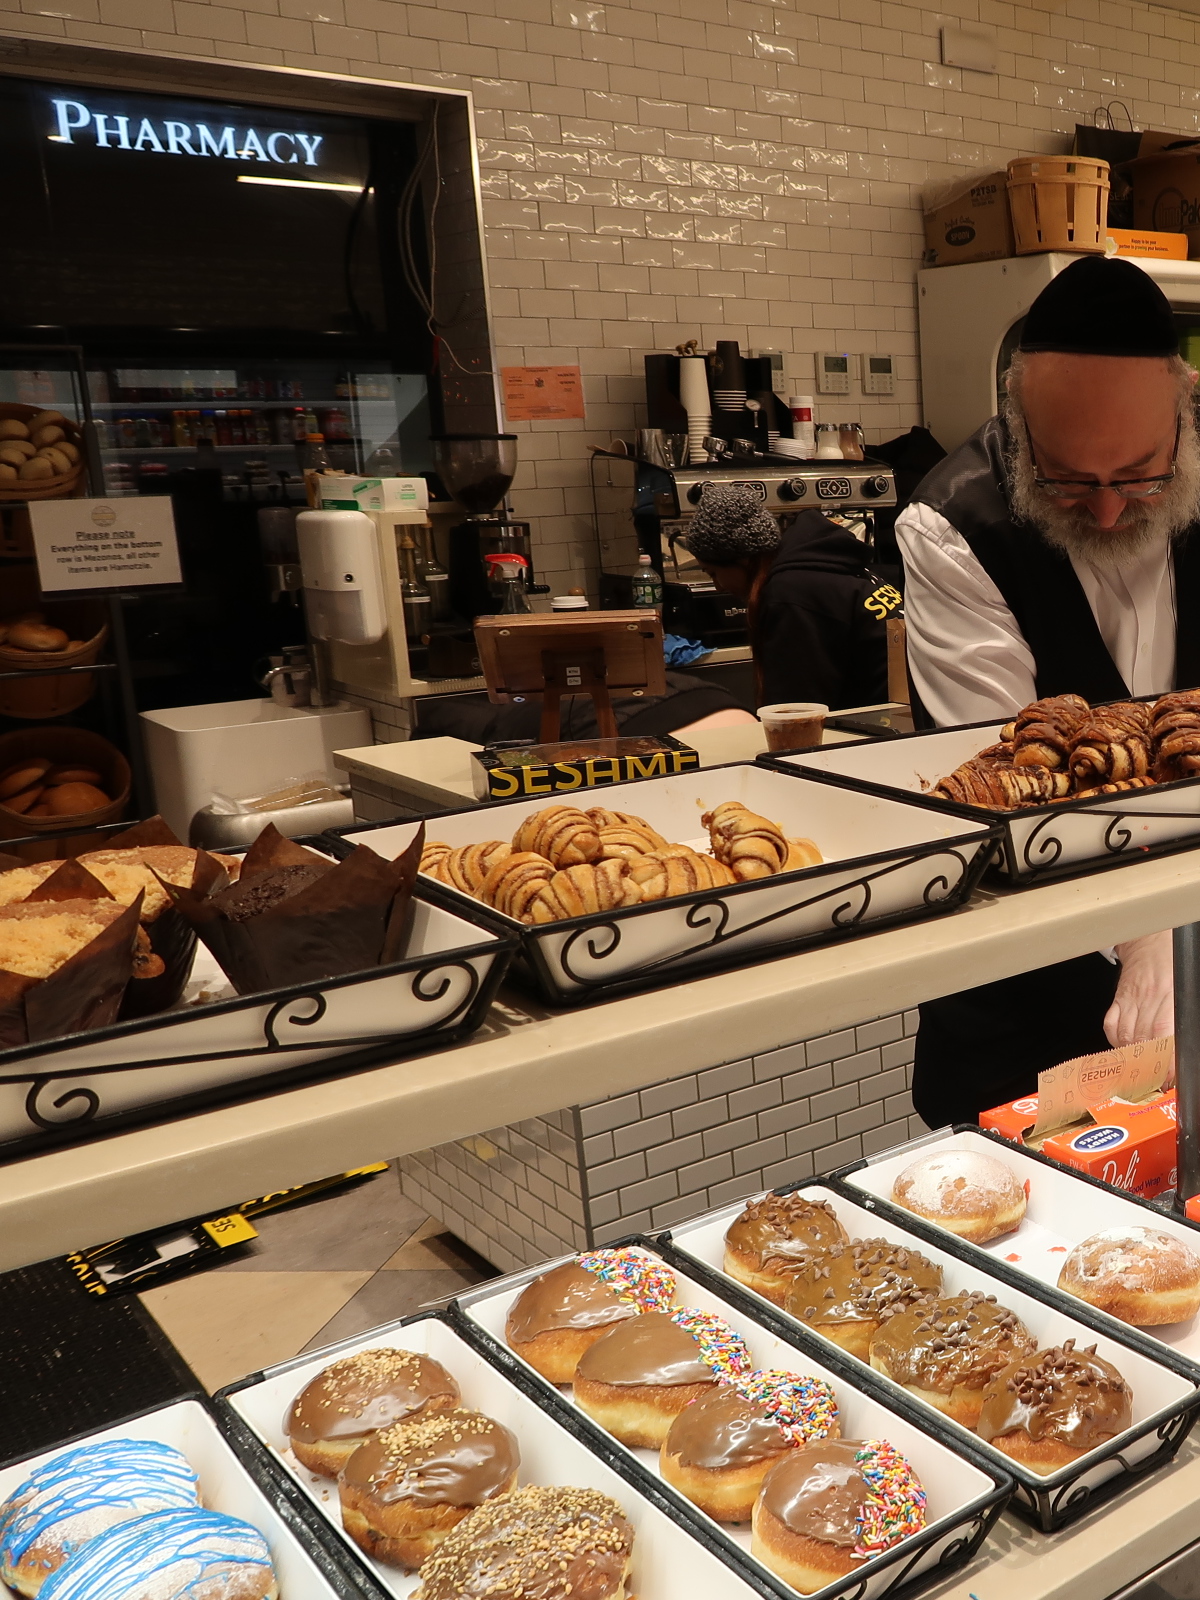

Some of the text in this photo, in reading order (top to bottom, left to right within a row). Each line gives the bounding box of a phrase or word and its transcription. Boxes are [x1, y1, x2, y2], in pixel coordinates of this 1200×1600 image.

[76, 530, 135, 541] Please note
[51, 543, 98, 553] Everything
[114, 542, 129, 550] the
[130, 540, 163, 549] bottom
[126, 552, 136, 560] all
[68, 566, 92, 574] items
[489, 751, 697, 797] SESAME
[1078, 1128, 1112, 1146] WACKS
[1088, 1131, 1120, 1149] HANDY
[1102, 1150, 1140, 1188] Deli
[1128, 1176, 1161, 1194] Food Wrap
